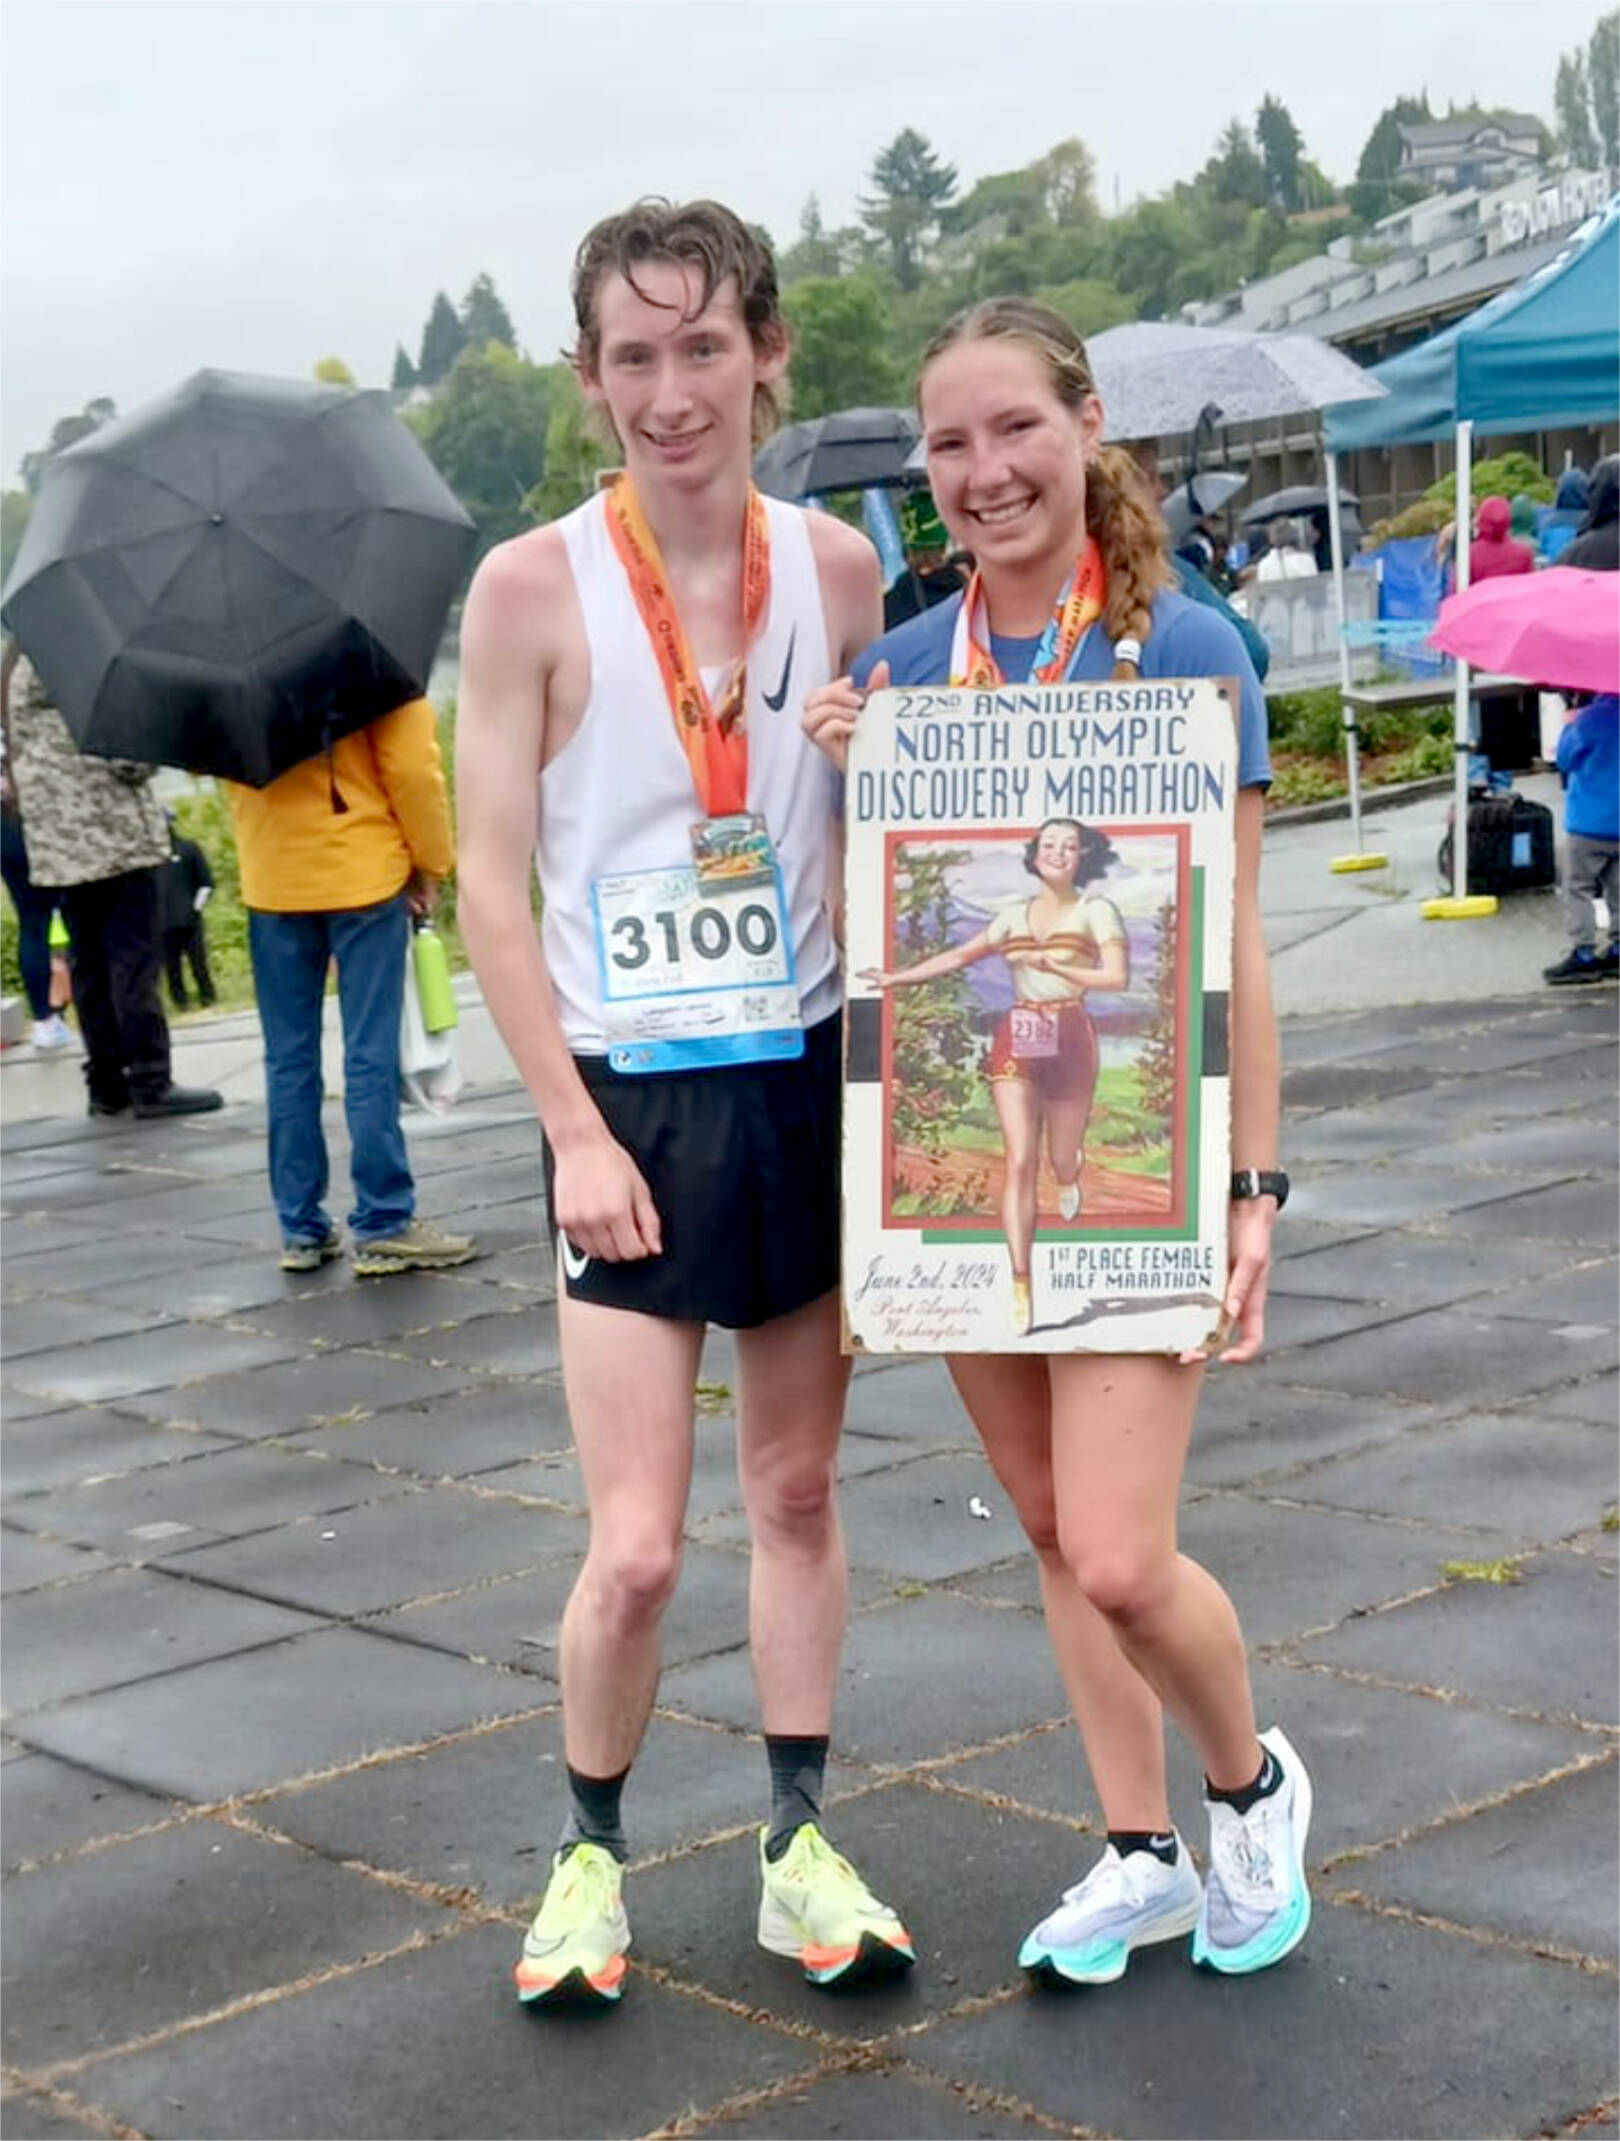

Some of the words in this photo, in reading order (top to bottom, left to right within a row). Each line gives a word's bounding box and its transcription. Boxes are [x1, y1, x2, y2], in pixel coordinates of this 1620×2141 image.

[973, 687, 1195, 716] ANNIVERSARY
[895, 721, 1009, 763] NORTH
[1028, 717, 1187, 759] OLYMPIC
[857, 767, 1030, 821] DISCOVERY
[1045, 761, 1225, 816] MARATHON
[610, 904, 778, 969] 3100
[1077, 1247, 1133, 1270] PLACE
[1141, 1247, 1213, 1270] FEMALE
[855, 1254, 901, 1302] June
[950, 1262, 999, 1289] 2024
[1051, 1272, 1098, 1289] HALF
[1106, 1272, 1212, 1289] MARATHON
[883, 1318, 968, 1341] Washington
